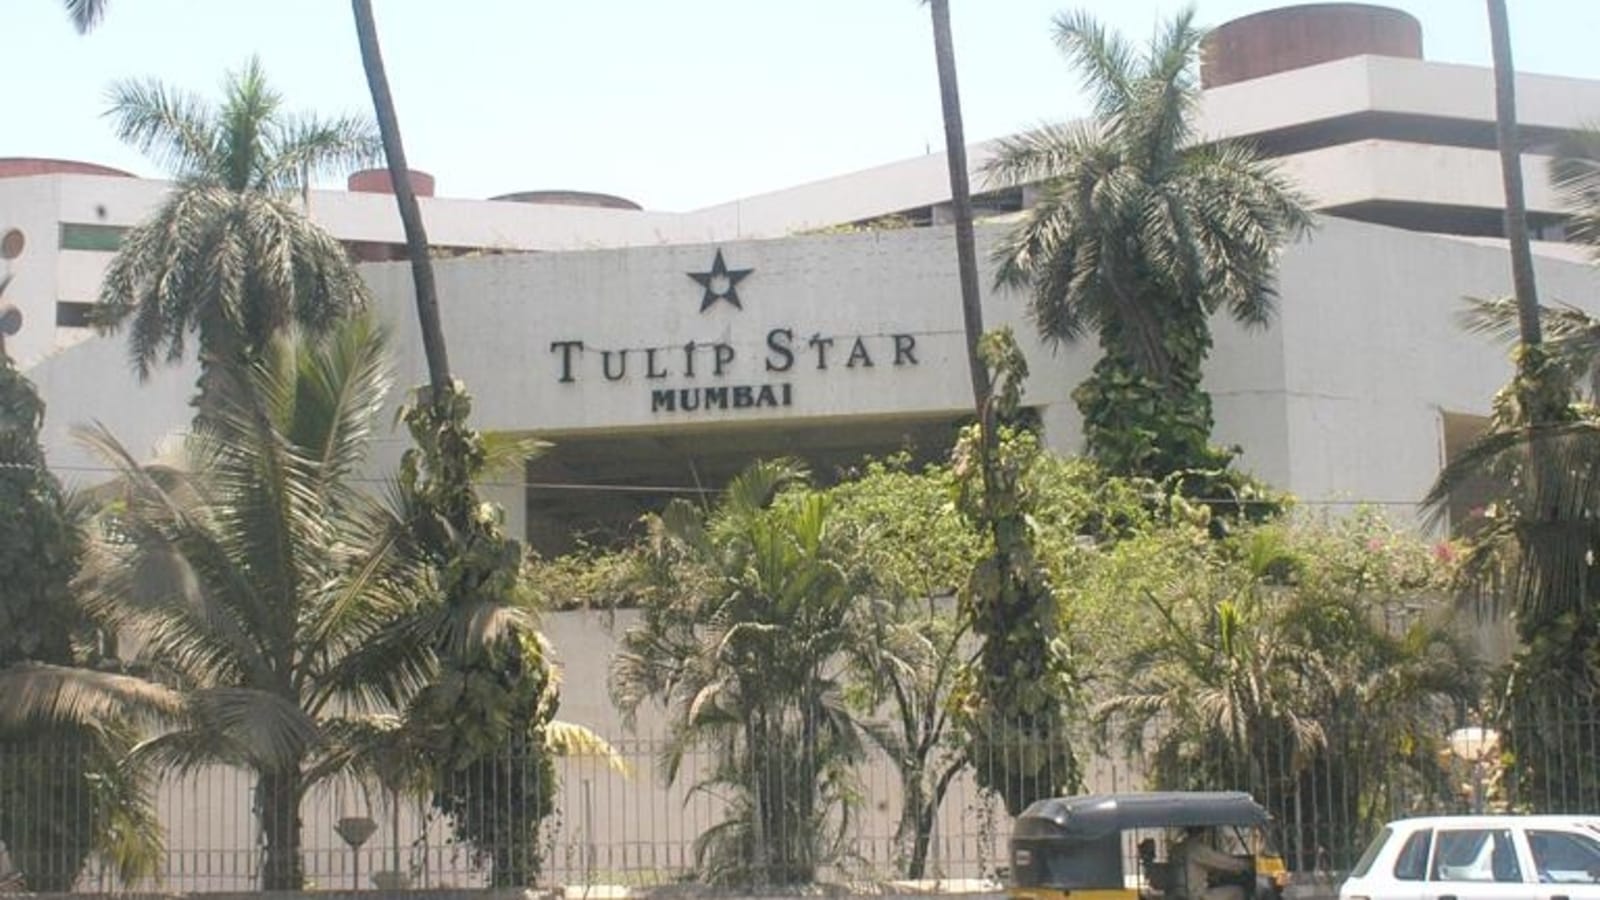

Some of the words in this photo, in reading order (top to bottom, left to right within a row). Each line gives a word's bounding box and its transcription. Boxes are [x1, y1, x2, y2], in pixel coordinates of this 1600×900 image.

[550, 340, 735, 383] TULIP
[765, 328, 919, 372] STAR
[651, 383, 793, 413] MUMBAI
